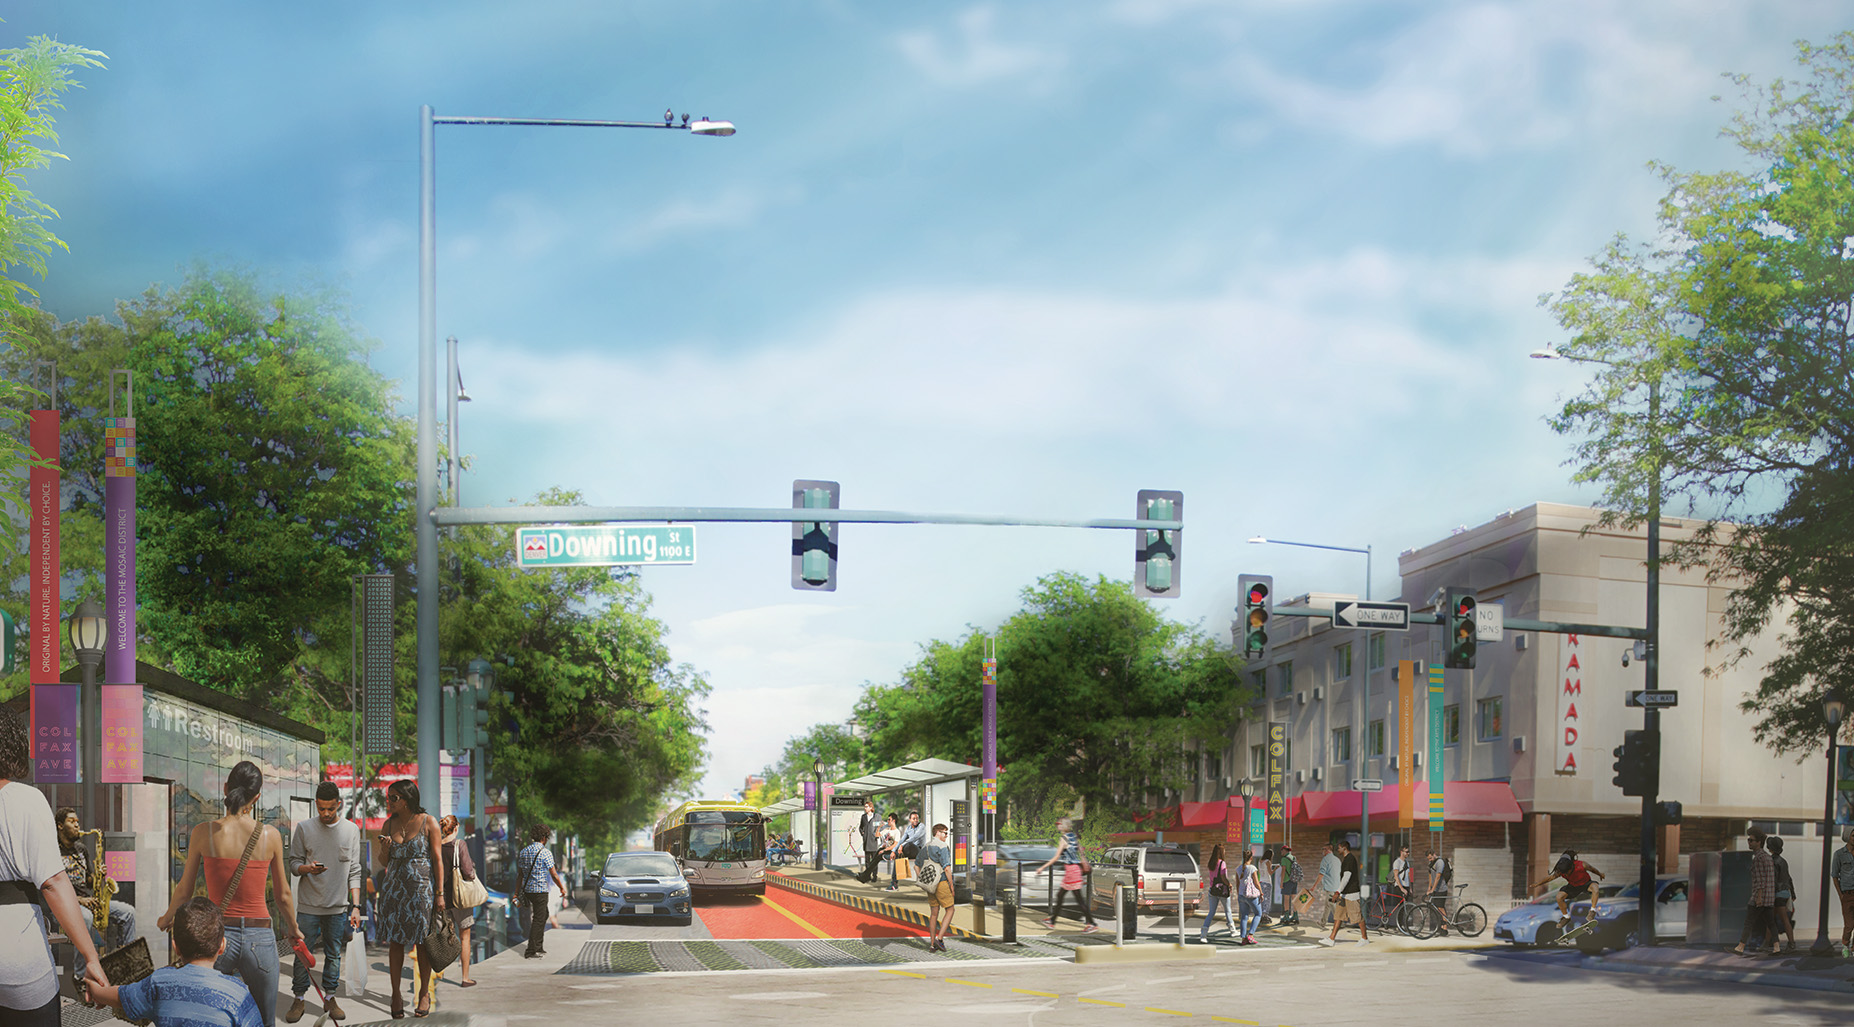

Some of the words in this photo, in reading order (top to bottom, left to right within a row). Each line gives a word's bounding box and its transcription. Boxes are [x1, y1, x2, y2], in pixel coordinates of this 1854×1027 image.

[42, 481, 50, 514] CHOICE.
[42, 515, 50, 525] BY
[118, 508, 126, 544] DISTRICT
[550, 530, 656, 562] Downing
[669, 532, 680, 542] St
[660, 546, 682, 557] 1100
[685, 546, 690, 556] E
[42, 528, 50, 584] INDEPENDENT
[118, 545, 126, 578] MOSAIC
[118, 580, 126, 596] THE
[42, 586, 50, 620] NATURE.
[118, 596, 126, 608] TO
[1357, 610, 1377, 620] ONE
[1380, 611, 1400, 621] WAY
[1479, 610, 1493, 621] NO
[42, 622, 50, 632] BY
[118, 610, 126, 650] WELCOME
[1477, 624, 1499, 634] URNS
[42, 634, 50, 672] ORIGINAL
[39, 726, 71, 737] COL
[106, 726, 138, 737] COL
[175, 708, 252, 753] Restroom
[40, 742, 71, 752] FAX
[106, 742, 139, 752] FAX
[39, 760, 71, 769] AVE
[106, 760, 139, 769] AVE
[1269, 726, 1284, 820] COLFAX
